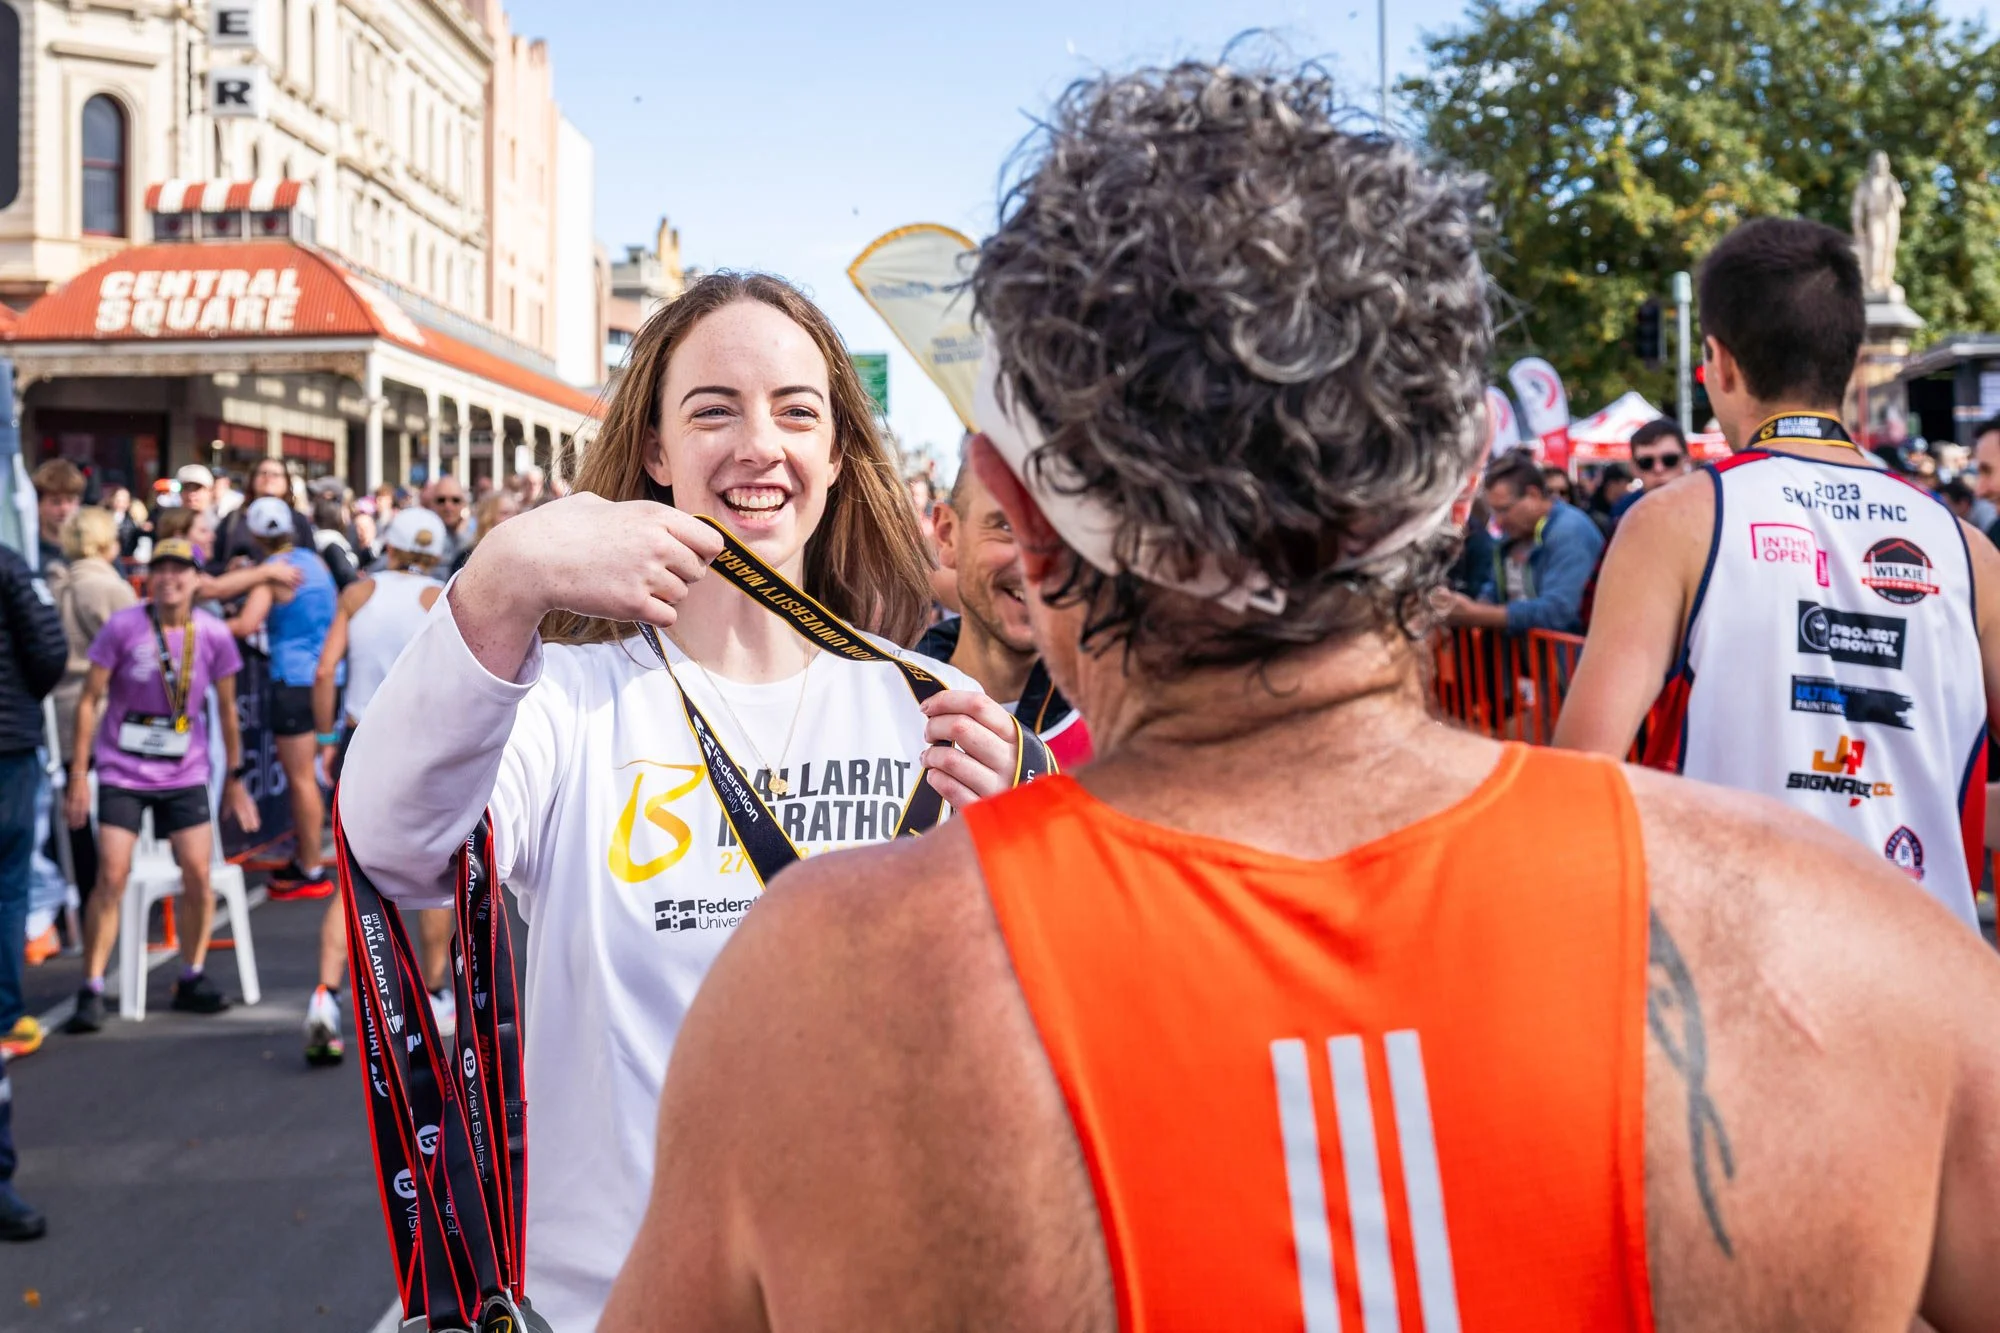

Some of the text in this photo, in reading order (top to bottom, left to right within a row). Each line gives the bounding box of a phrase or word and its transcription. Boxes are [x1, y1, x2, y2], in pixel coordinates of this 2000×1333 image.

[217, 9, 249, 37] E
[217, 80, 252, 106] R
[100, 267, 301, 299] CENTRAL
[95, 297, 299, 337] SQUARE
[1813, 481, 1861, 501] 2023
[1866, 503, 1908, 522] FNC
[1762, 536, 1810, 552] IN THE
[1763, 548, 1812, 565] OPEN
[715, 547, 769, 588] MARA
[1874, 565, 1924, 580] WILKIE
[757, 586, 849, 649] UNIVERSITY
[1830, 623, 1900, 644] PROJECT
[709, 756, 741, 814] University
[712, 746, 760, 823] Federation
[737, 757, 911, 802] ALLARAT
[717, 799, 905, 847] MRATHO
[371, 913, 385, 943] CITY OF
[361, 914, 390, 996] BALLARAT
[468, 1080, 480, 1120] Visit
